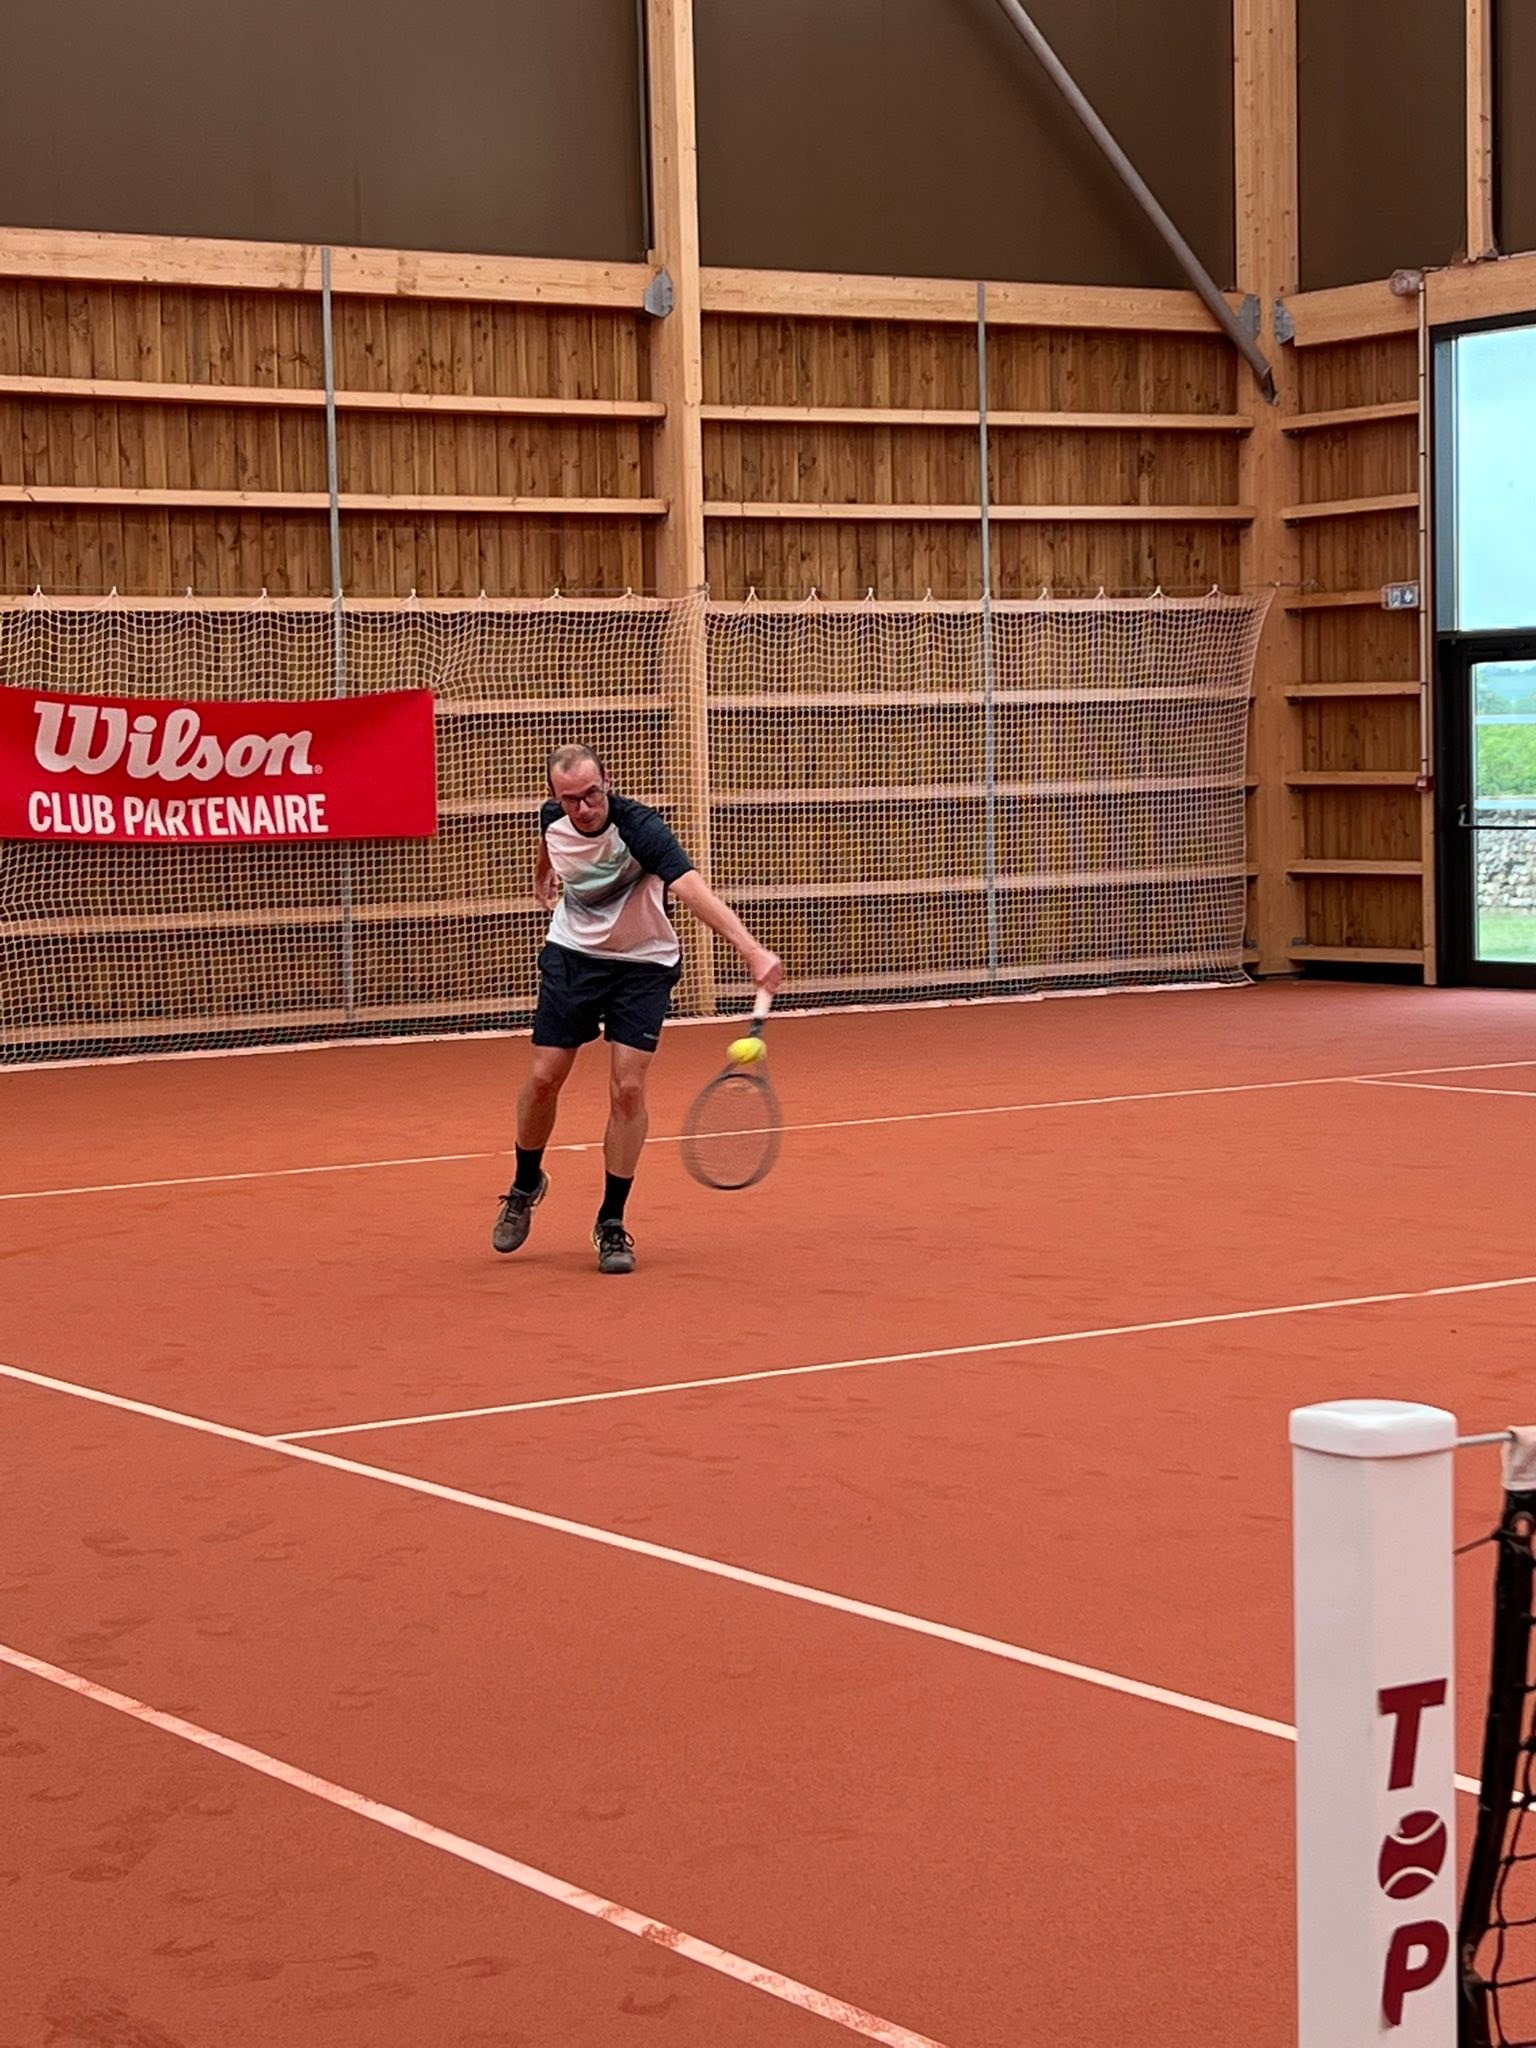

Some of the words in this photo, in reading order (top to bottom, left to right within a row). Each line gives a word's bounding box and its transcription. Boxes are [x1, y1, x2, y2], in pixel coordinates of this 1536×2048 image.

[34, 701, 315, 781] Wilson
[28, 791, 116, 834] CLUB
[124, 793, 329, 836] PARTENAIRE
